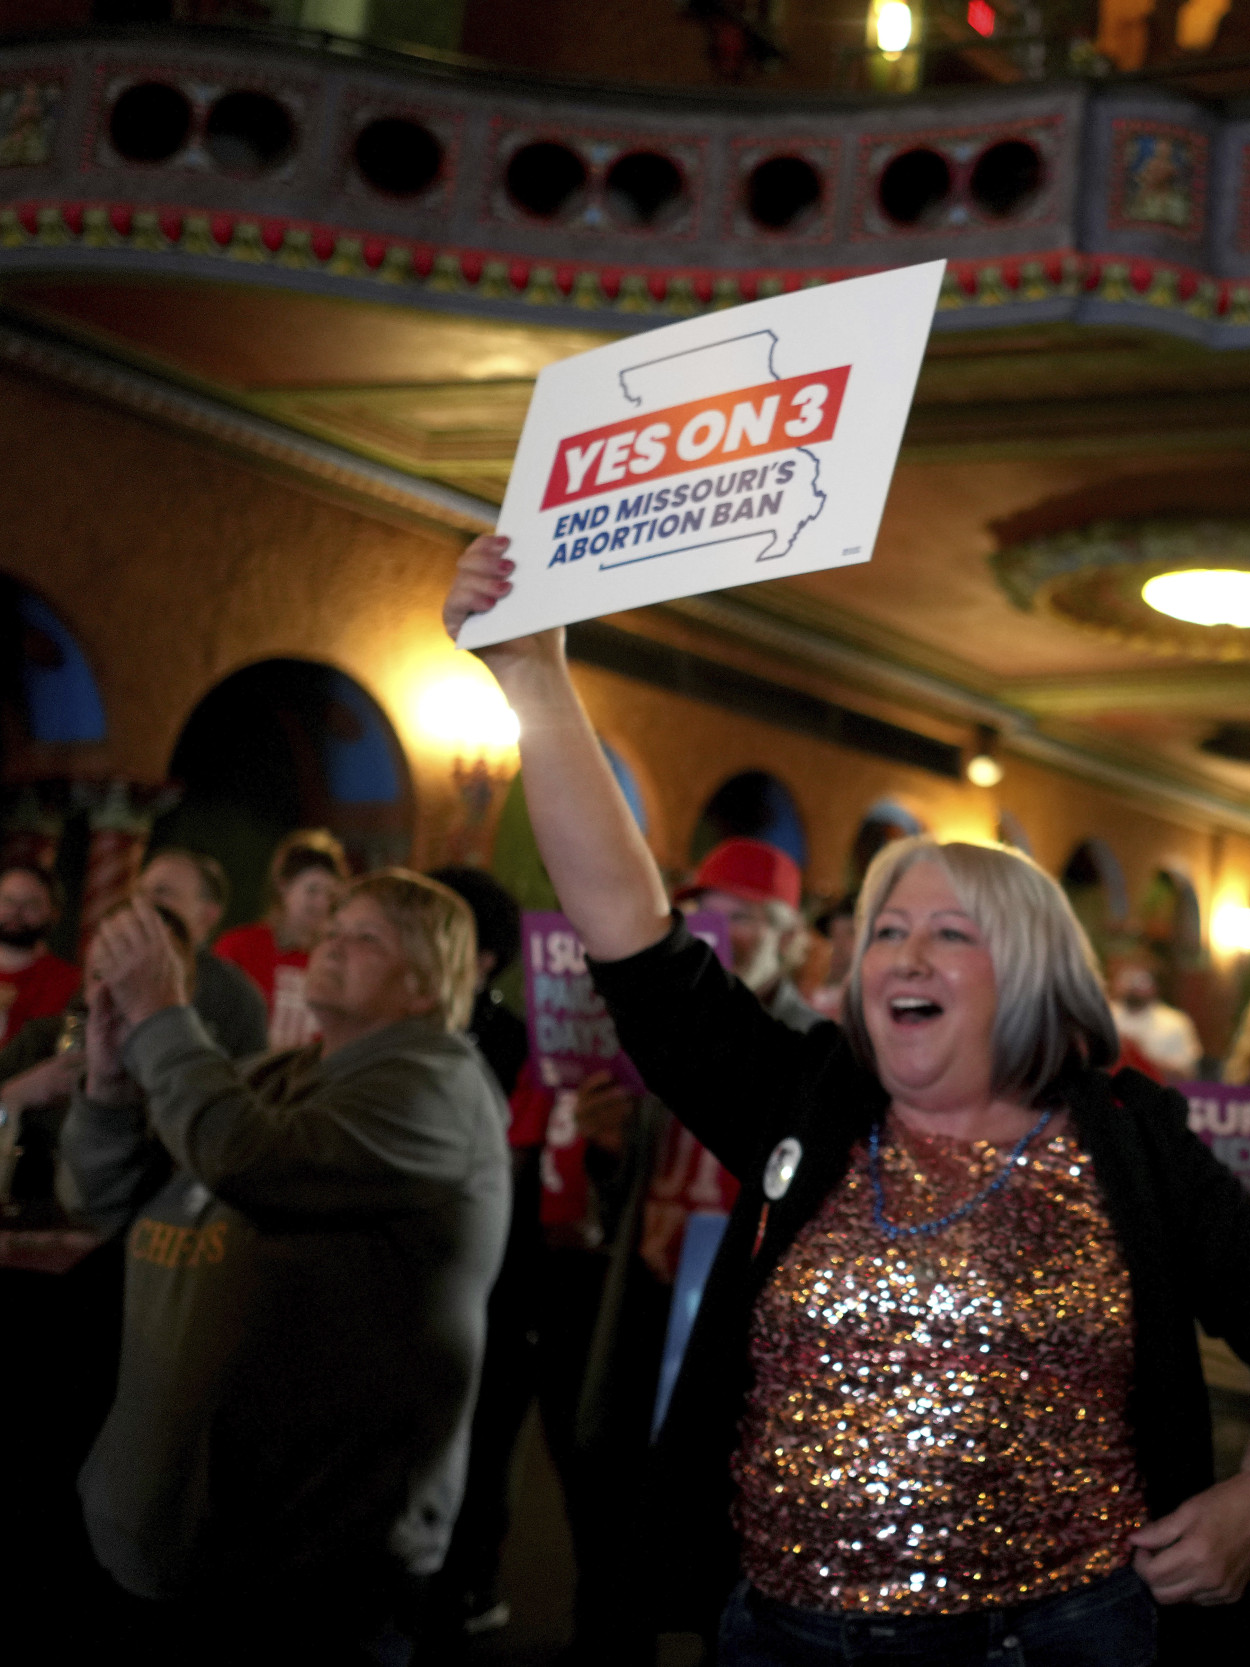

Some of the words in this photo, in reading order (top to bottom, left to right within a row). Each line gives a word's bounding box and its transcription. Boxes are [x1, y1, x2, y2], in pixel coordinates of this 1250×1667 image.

[564, 422, 672, 495] YES
[676, 394, 782, 462] ON
[784, 383, 829, 437] 3
[547, 507, 707, 568] ABORTION
[709, 490, 785, 528] BAN
[552, 505, 610, 540] END
[615, 460, 797, 523] MISSOURI'S
